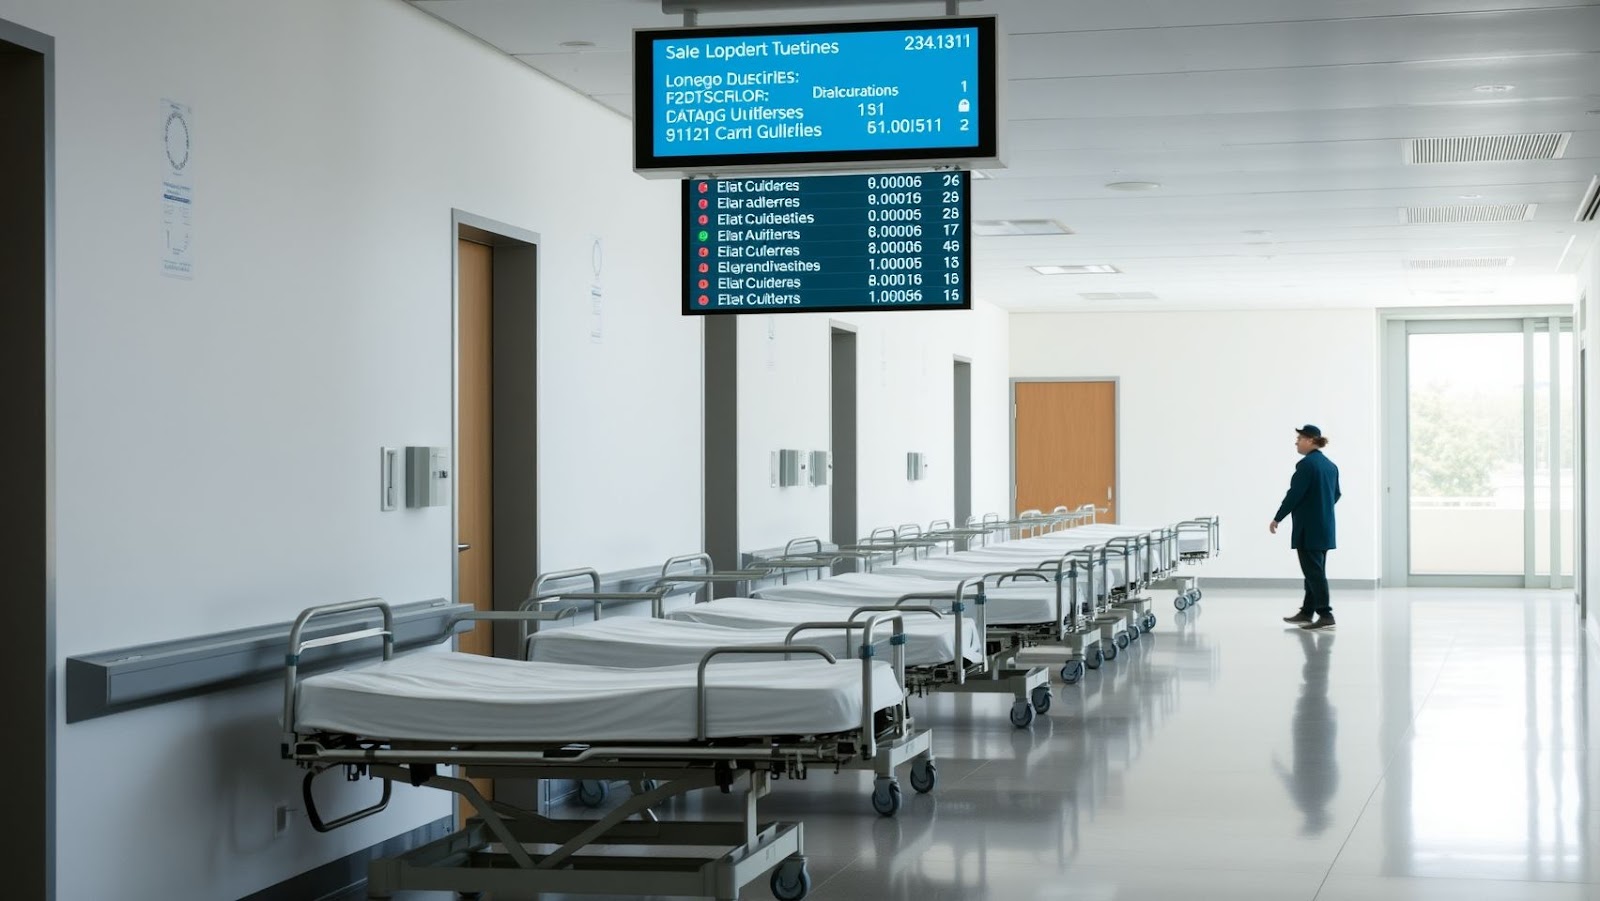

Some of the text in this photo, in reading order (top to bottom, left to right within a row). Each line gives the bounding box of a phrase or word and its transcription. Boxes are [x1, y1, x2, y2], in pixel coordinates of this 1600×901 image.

[960, 80, 967, 92] 1
[960, 118, 969, 131] 2
[943, 224, 959, 236] 17
